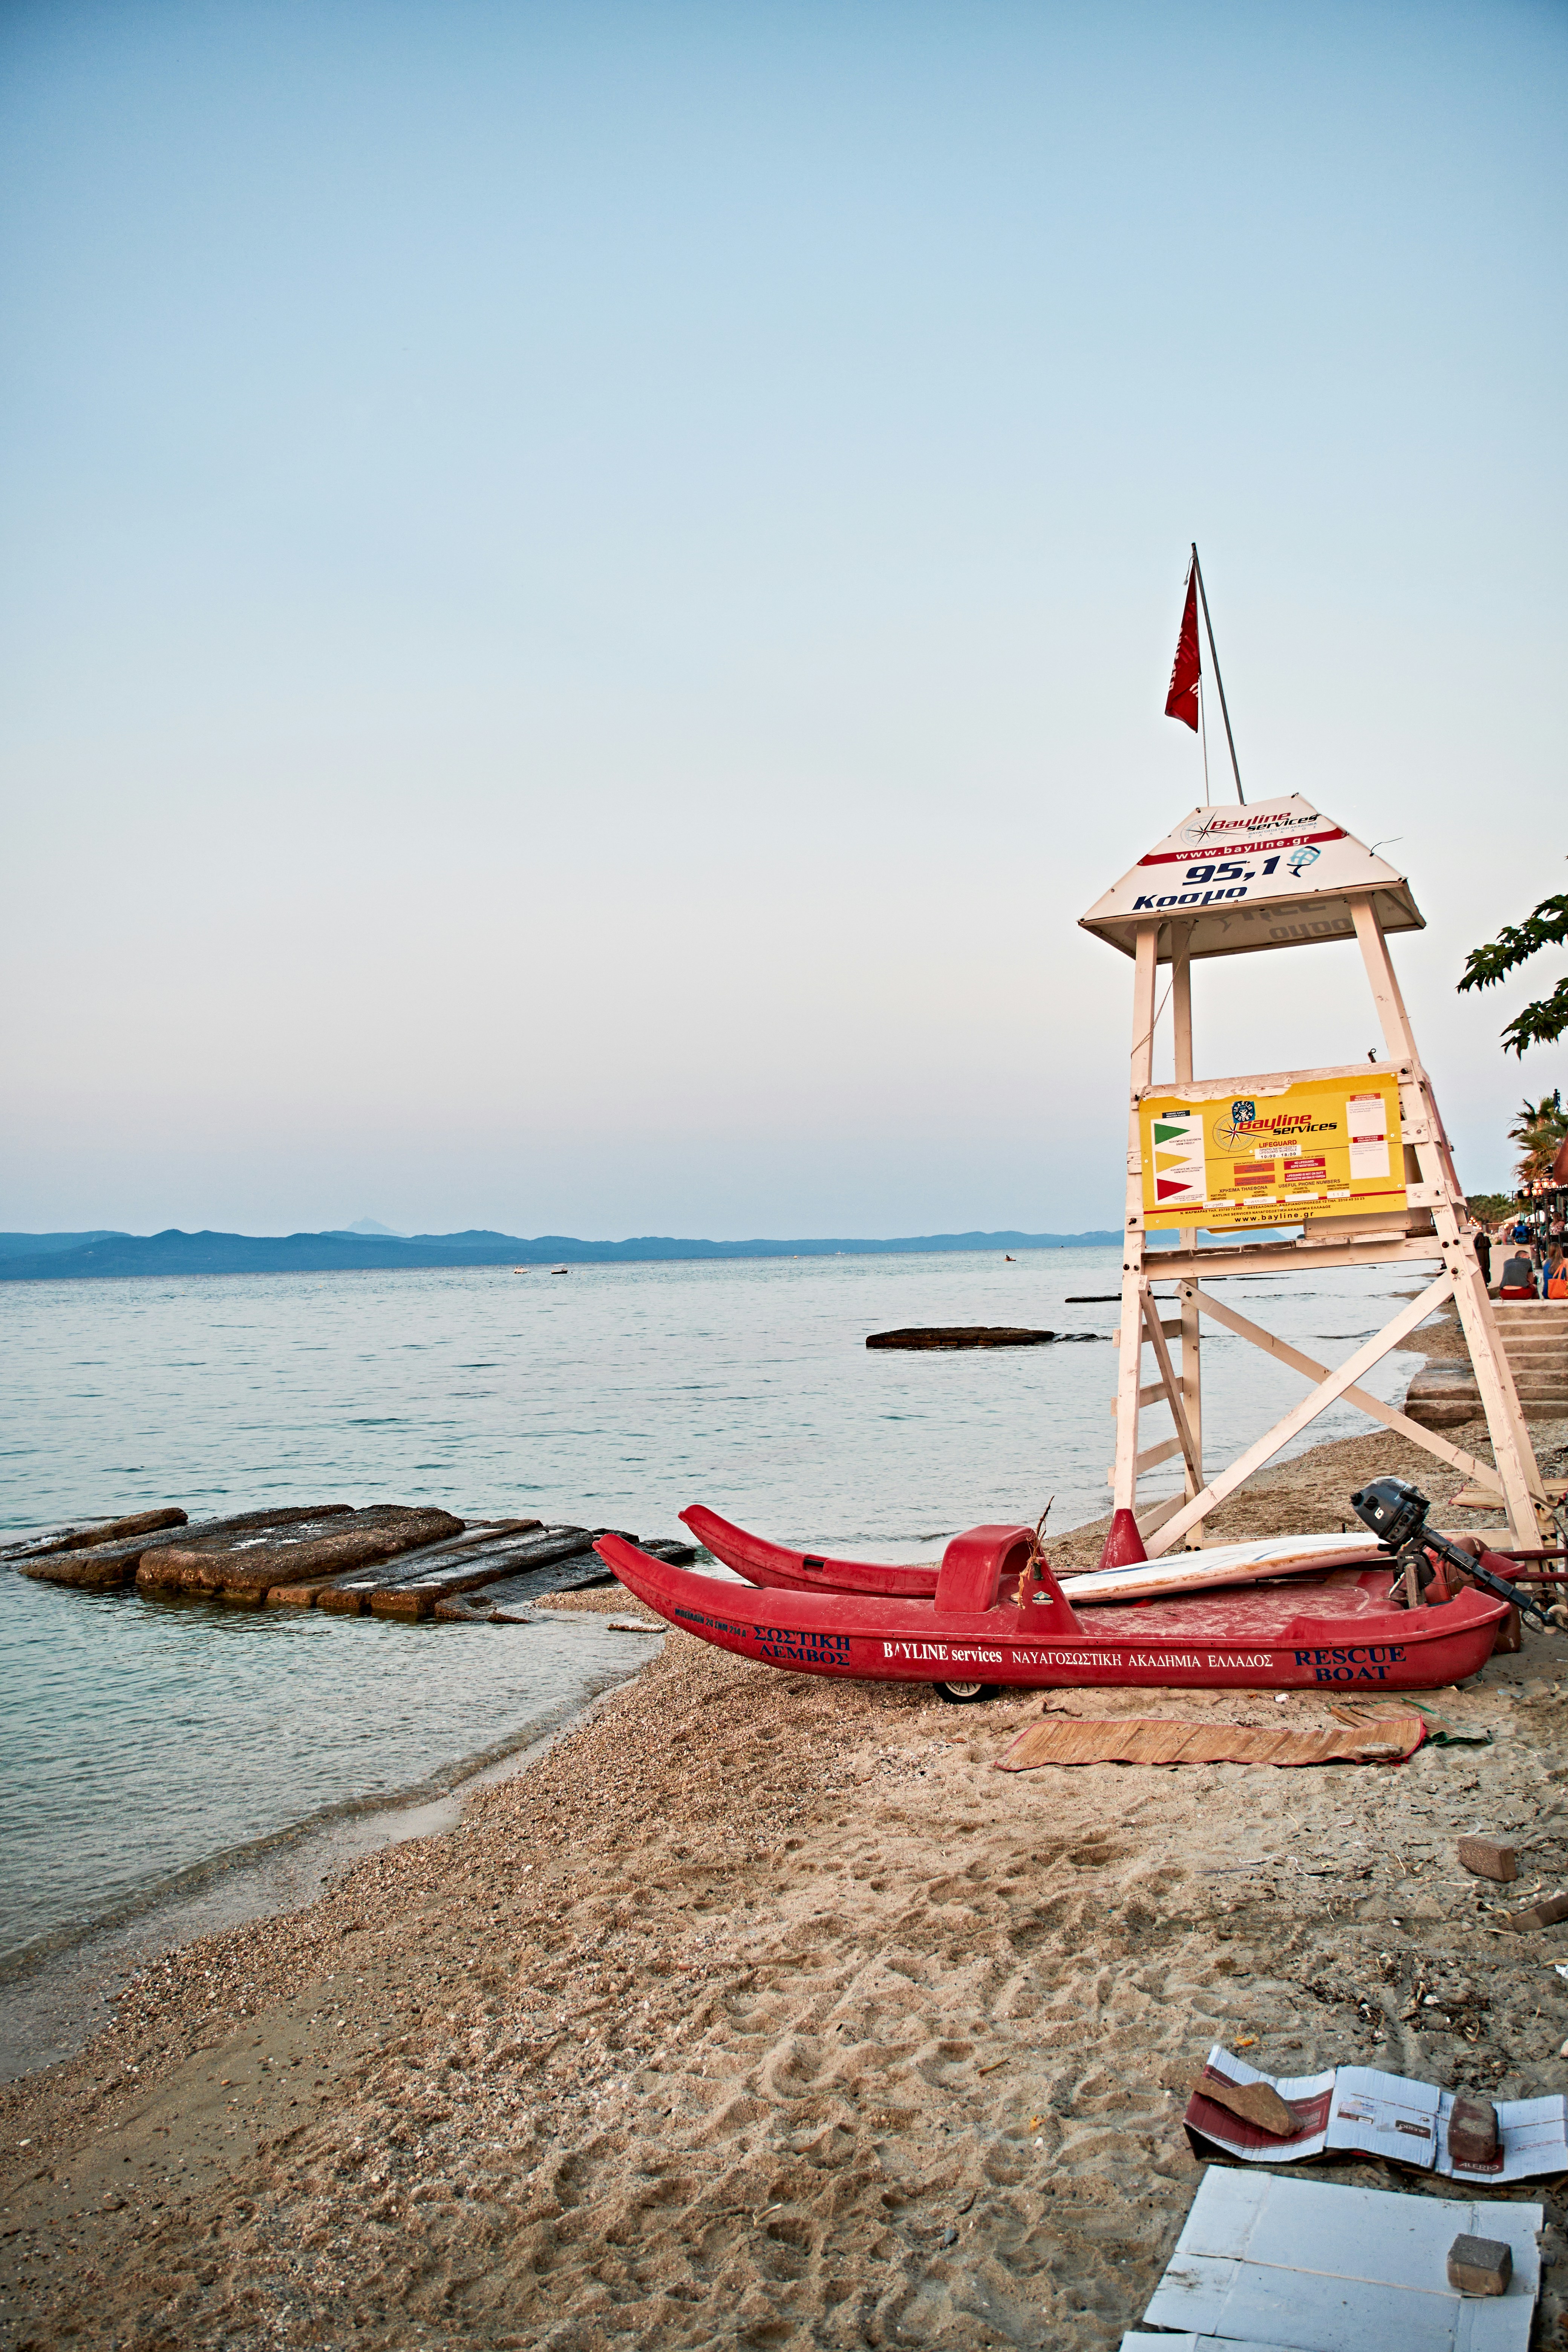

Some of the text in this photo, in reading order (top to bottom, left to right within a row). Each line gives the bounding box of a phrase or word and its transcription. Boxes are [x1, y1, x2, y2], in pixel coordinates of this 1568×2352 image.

[1210, 812, 1291, 830] Bayline
[1246, 814, 1319, 831] services
[1176, 836, 1309, 860] www.bayline.gr
[1182, 856, 1281, 886] 95,1
[1132, 887, 1247, 910] Κοσμο
[1239, 1115, 1312, 1130] Bayline
[1273, 1122, 1337, 1135] services
[1259, 1139, 1297, 1148] LIFEGUARD
[1234, 1211, 1314, 1222] www.bayline.gr
[705, 1617, 714, 1627] 24
[753, 1626, 851, 1651] ΣΩΣΤΙΚΗ
[760, 1643, 850, 1666] ΛΕΜΒΟΣ
[952, 1646, 1002, 1663] services
[1012, 1652, 1122, 1666] ΝΑΥΑΓΟΣΩΣΤΙΚΗ
[1129, 1654, 1202, 1668] ΑΚΑΔΗΜΙΑ
[1208, 1654, 1273, 1668] ΕΛΛΑΔΟΣ
[1293, 1646, 1407, 1666] RESCUE
[1315, 1665, 1390, 1682] BOAT
[1459, 2162, 1499, 2171] ALERIO
